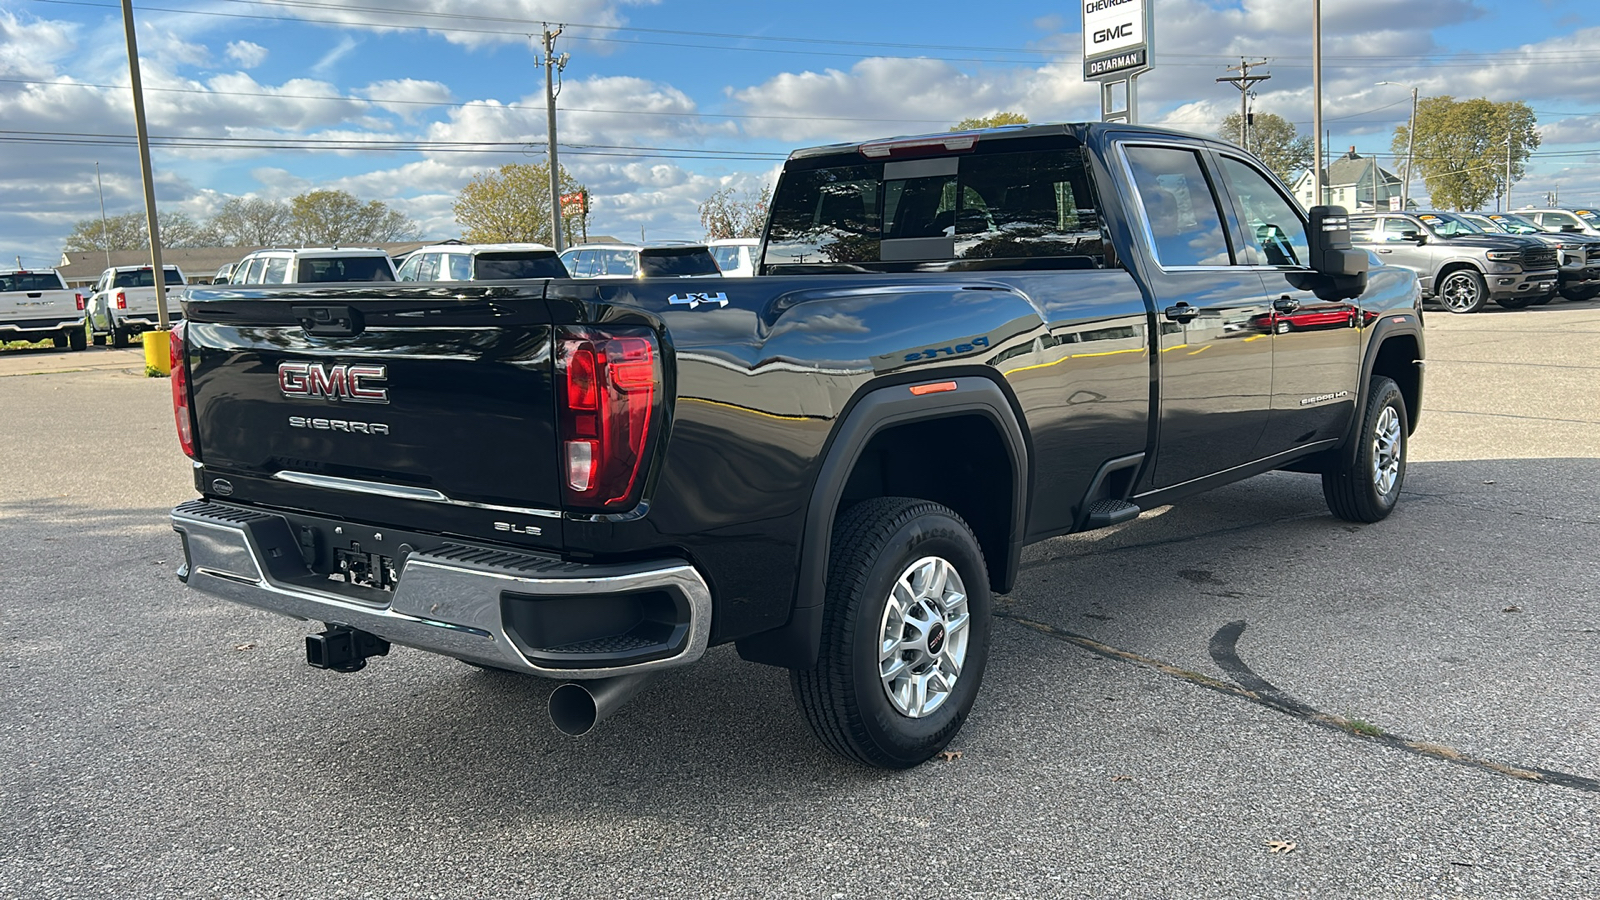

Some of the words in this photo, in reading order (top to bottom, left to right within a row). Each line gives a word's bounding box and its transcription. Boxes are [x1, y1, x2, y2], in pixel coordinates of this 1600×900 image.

[1093, 22, 1133, 44] GMC
[1091, 53, 1137, 73] DEYARMAN
[278, 361, 390, 404] GMC
[1300, 393, 1334, 405] SIERRA
[1335, 390, 1348, 398] HD
[288, 416, 390, 436] SIERRA
[493, 521, 542, 536] SLE
